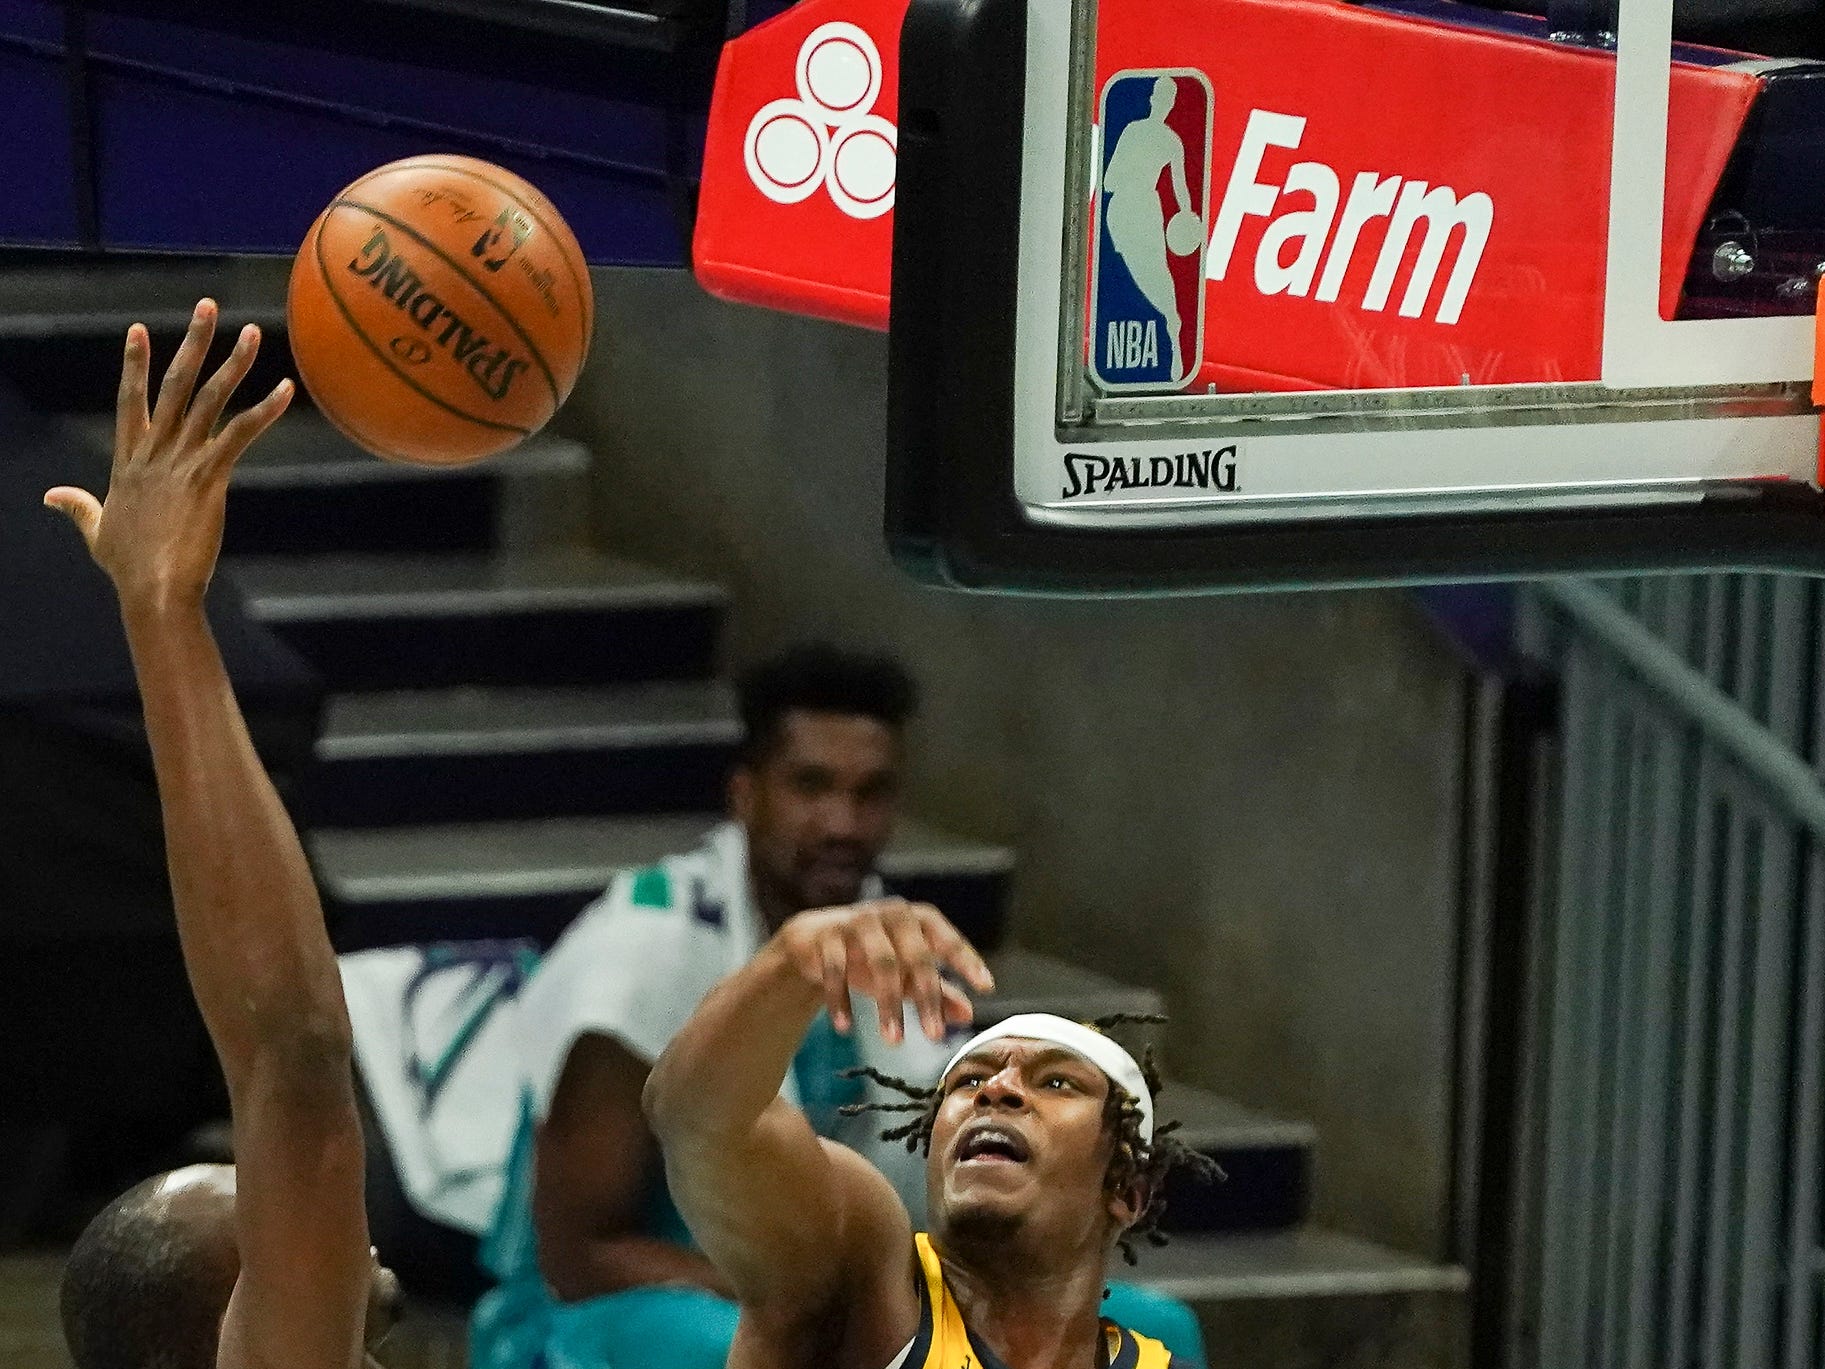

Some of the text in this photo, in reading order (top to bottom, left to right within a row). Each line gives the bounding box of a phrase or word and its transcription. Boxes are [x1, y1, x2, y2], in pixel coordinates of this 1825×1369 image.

[1207, 107, 1495, 326] Farm
[347, 228, 531, 402] SPALDING
[1105, 319, 1159, 371] NBA
[1061, 444, 1238, 500] SPALDING
